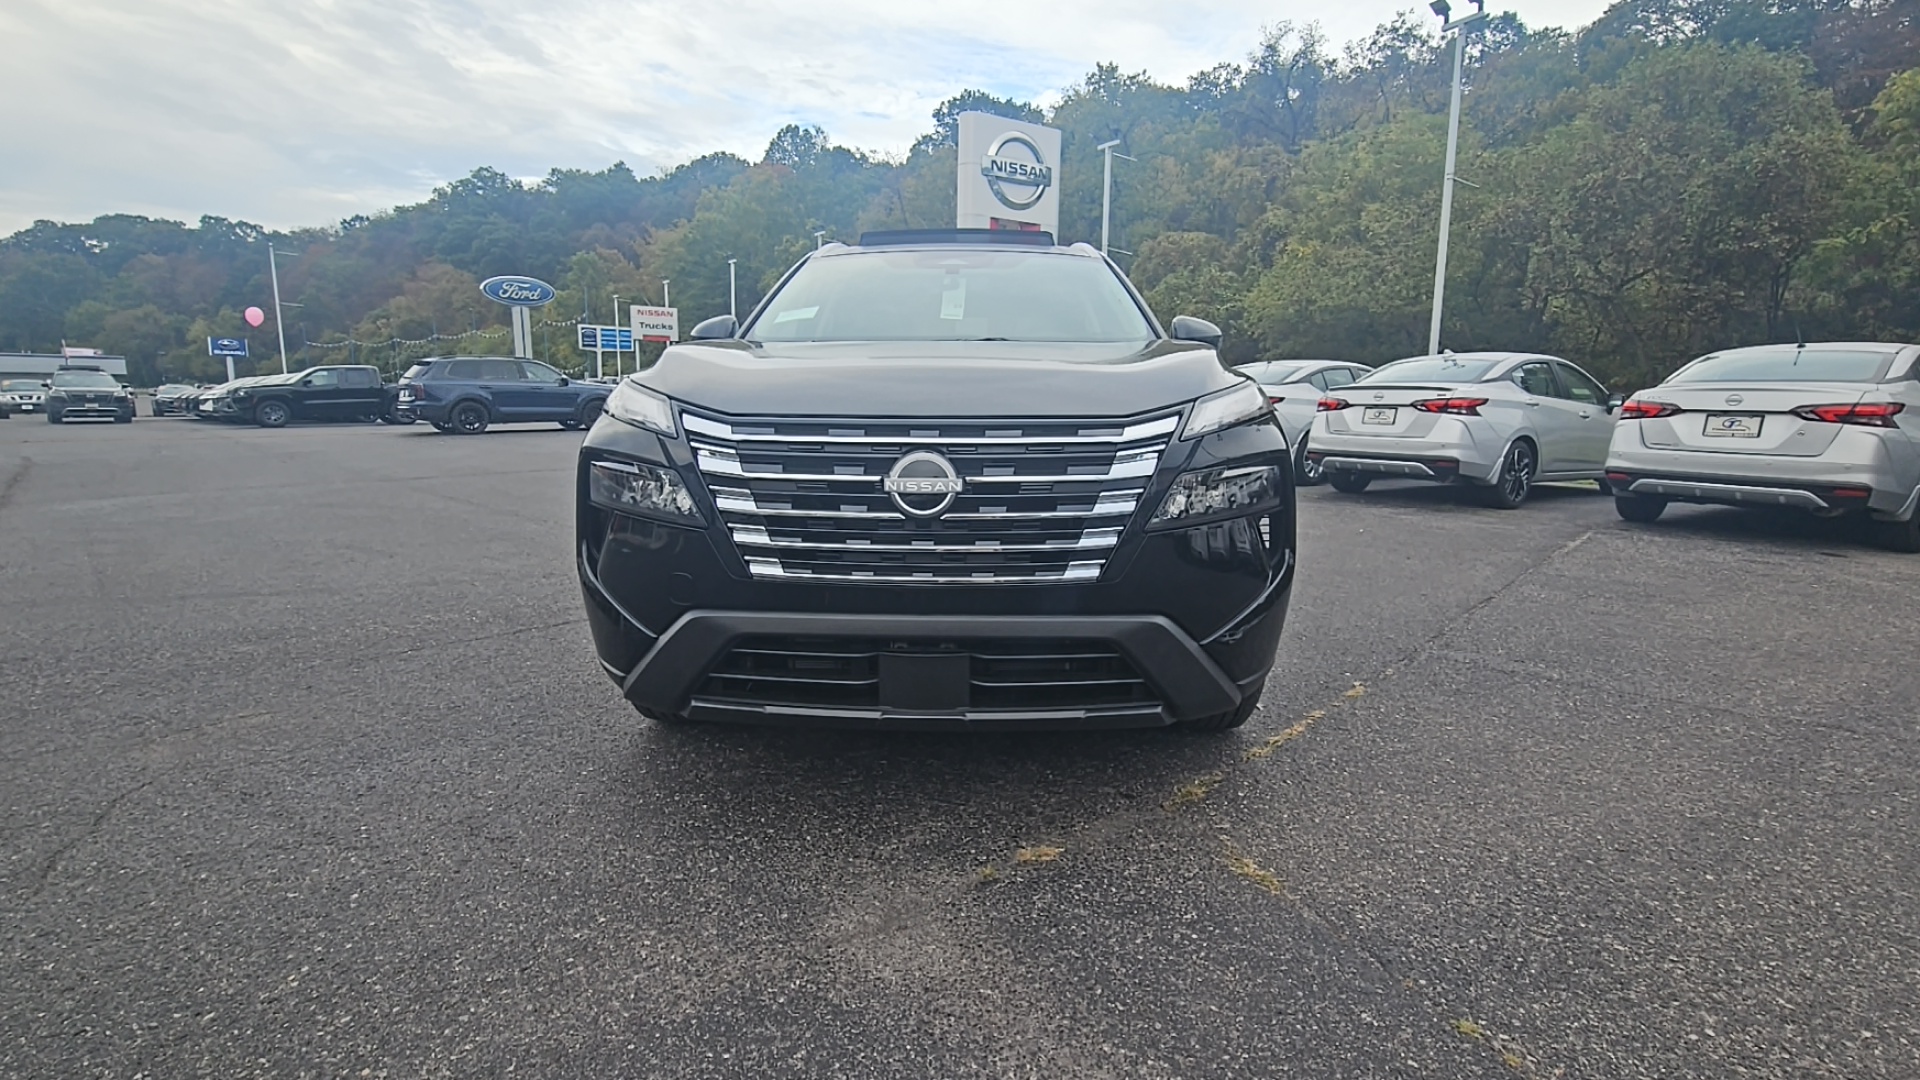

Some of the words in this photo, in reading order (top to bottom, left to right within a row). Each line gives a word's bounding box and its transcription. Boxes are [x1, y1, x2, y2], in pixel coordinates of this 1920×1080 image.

[991, 159, 1048, 179] NISSAN
[498, 281, 542, 300] Ford
[637, 309, 674, 318] NISSAN
[639, 321, 674, 331] Trucks
[886, 481, 961, 492] NISSAN
